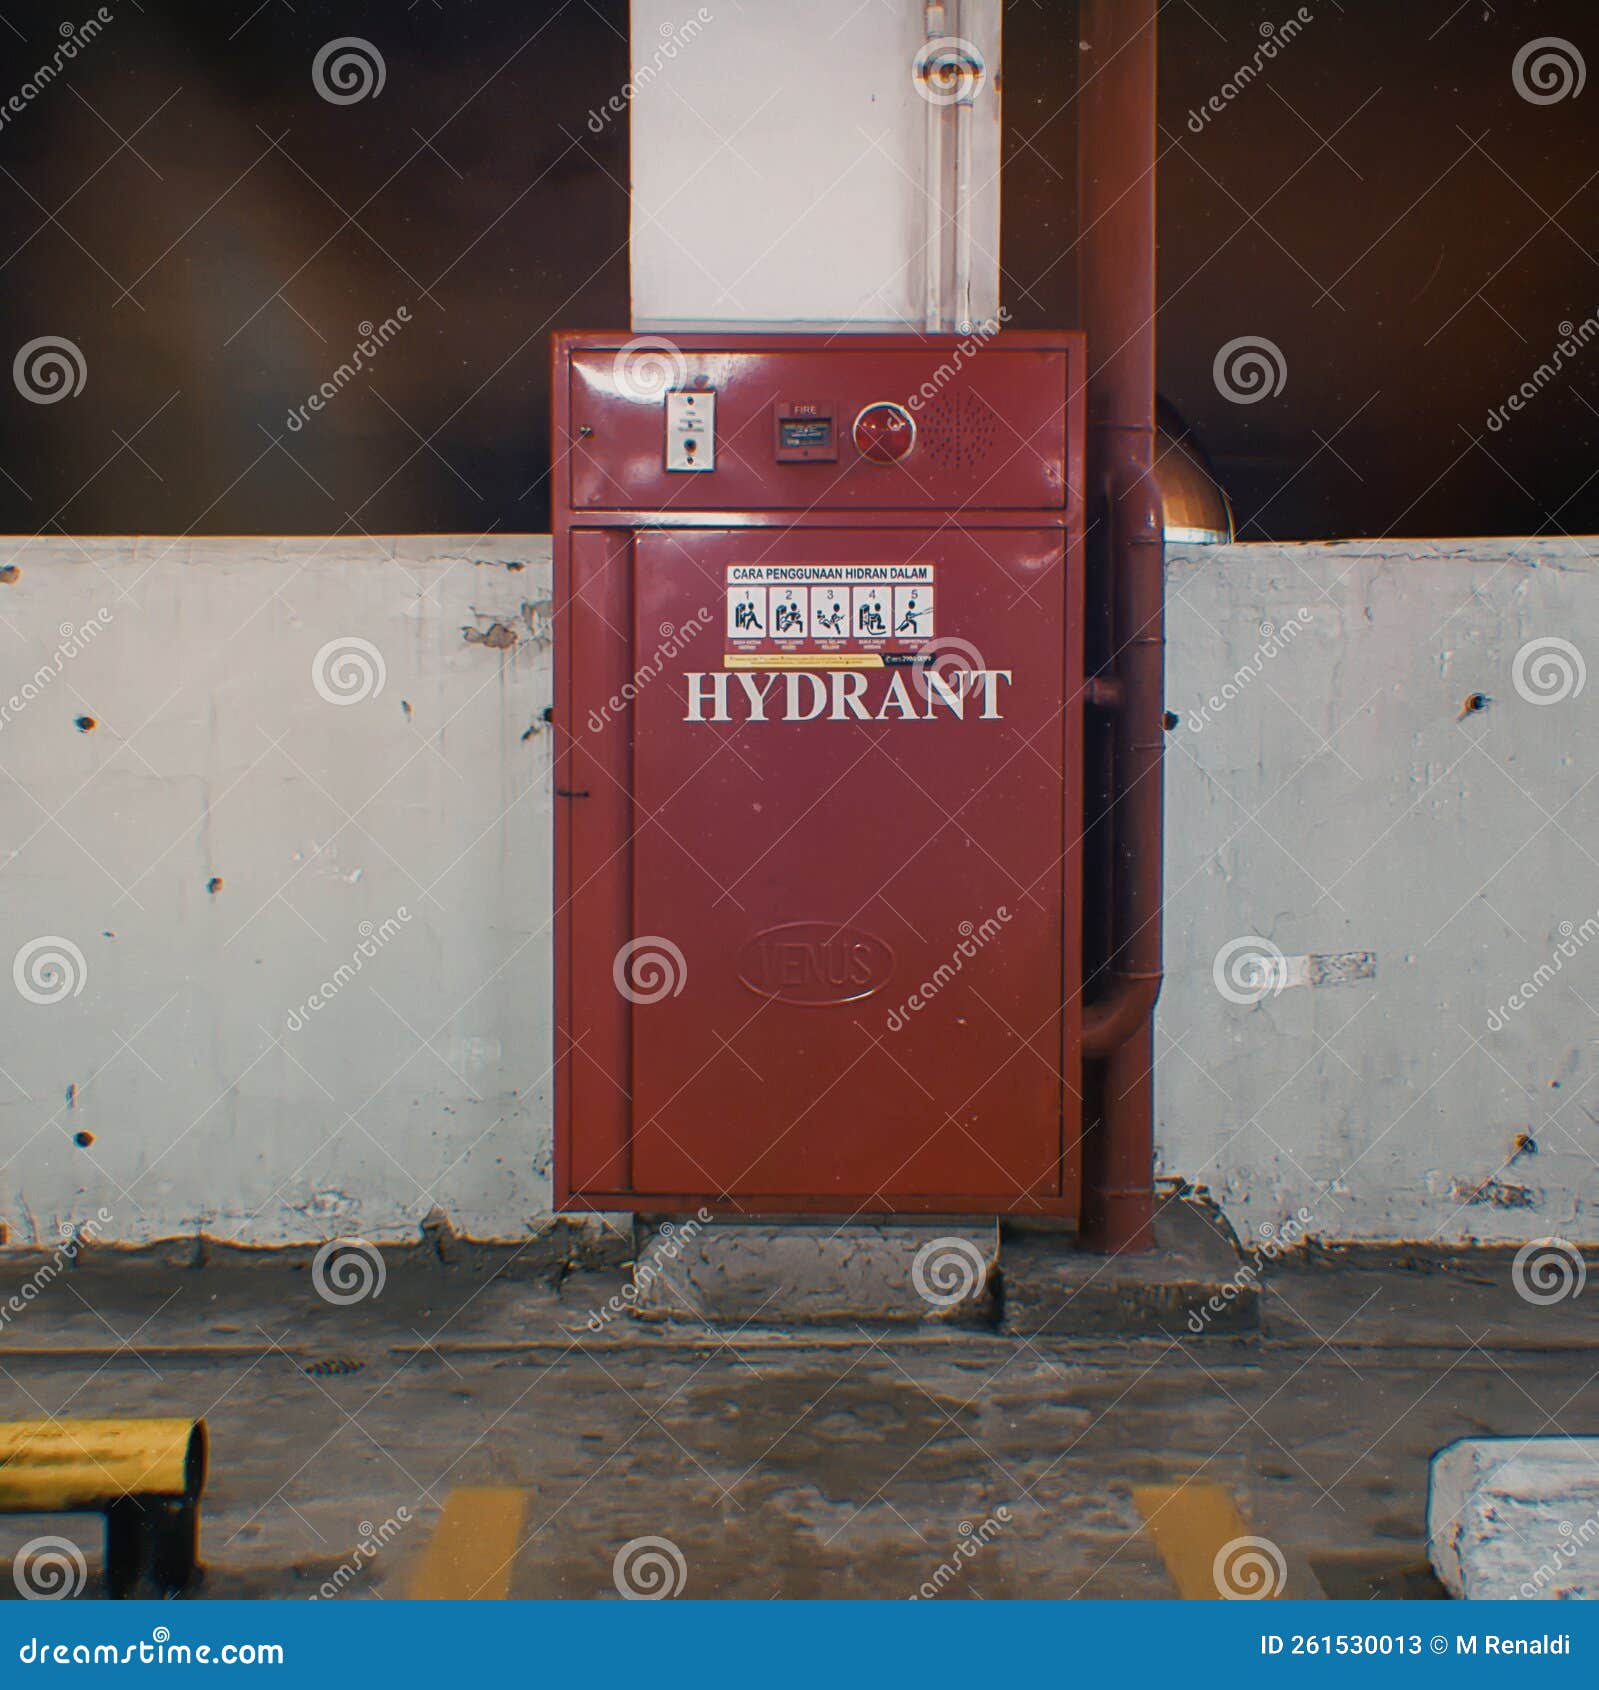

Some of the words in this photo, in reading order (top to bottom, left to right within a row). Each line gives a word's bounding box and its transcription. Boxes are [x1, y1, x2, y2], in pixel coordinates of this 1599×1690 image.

[794, 405, 817, 415] FIRE
[733, 568, 764, 580] CARA
[766, 568, 842, 580] PENGGUNAAN
[845, 568, 887, 580] HIDRAN
[890, 568, 927, 579] DALAM
[745, 590, 750, 599] 1
[785, 590, 793, 600] 2
[827, 590, 834, 600] 3
[868, 589, 876, 599] 4
[911, 589, 918, 599] 5
[683, 670, 1012, 722] HYDRANT
[760, 943, 872, 985] VENUS
